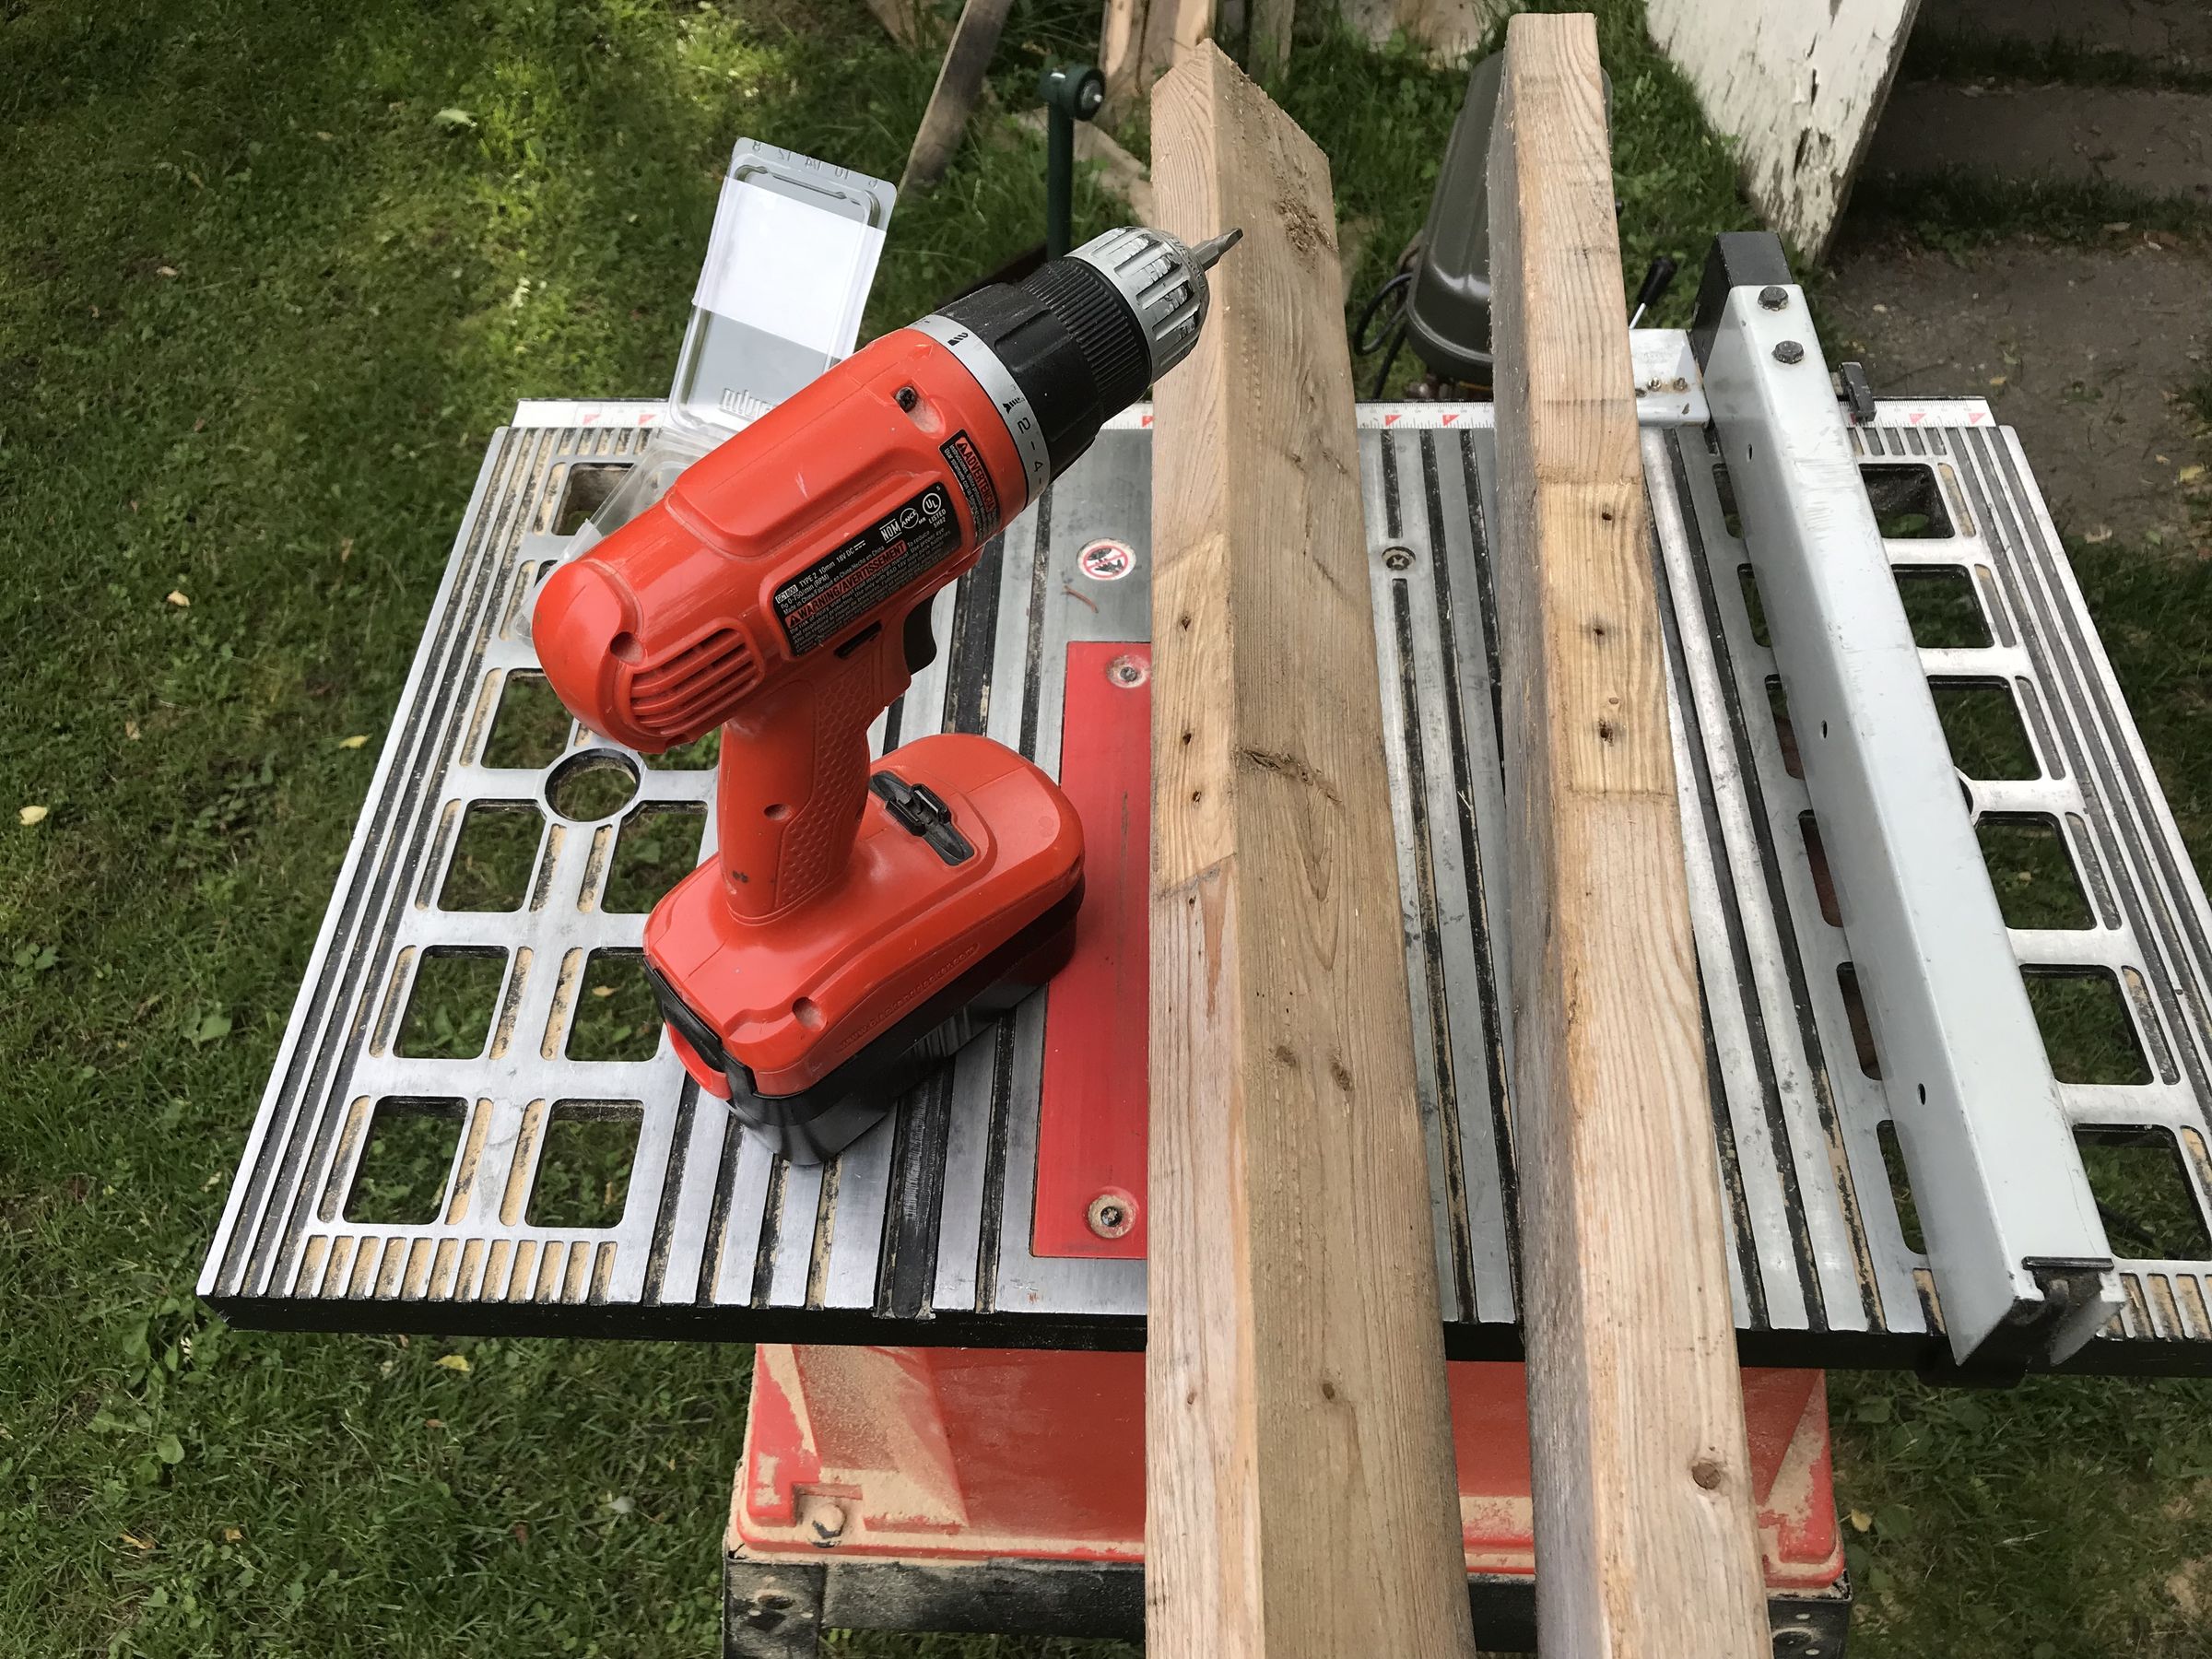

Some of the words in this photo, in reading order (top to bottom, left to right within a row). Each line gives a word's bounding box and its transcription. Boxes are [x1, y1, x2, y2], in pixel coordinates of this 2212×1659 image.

[1018, 417, 1030, 434] 2
[1034, 461, 1043, 472] 4
[963, 451, 995, 512] ADVERTENCIA
[901, 510, 917, 527] ANCE
[925, 498, 938, 509] UL
[928, 509, 947, 524] LISTED
[880, 521, 901, 541] NOM
[777, 586, 796, 603] GC1800
[800, 575, 813, 587] TYPE
[819, 560, 835, 574] 10mm
[837, 553, 846, 562] 18V
[846, 547, 854, 557] DC
[784, 604, 796, 615] Made
[872, 546, 884, 557] China
[788, 583, 814, 605] 0-750/min
[814, 573, 829, 588] (RPM)
[800, 545, 905, 617] WARNING/AVERTISSEMENT
